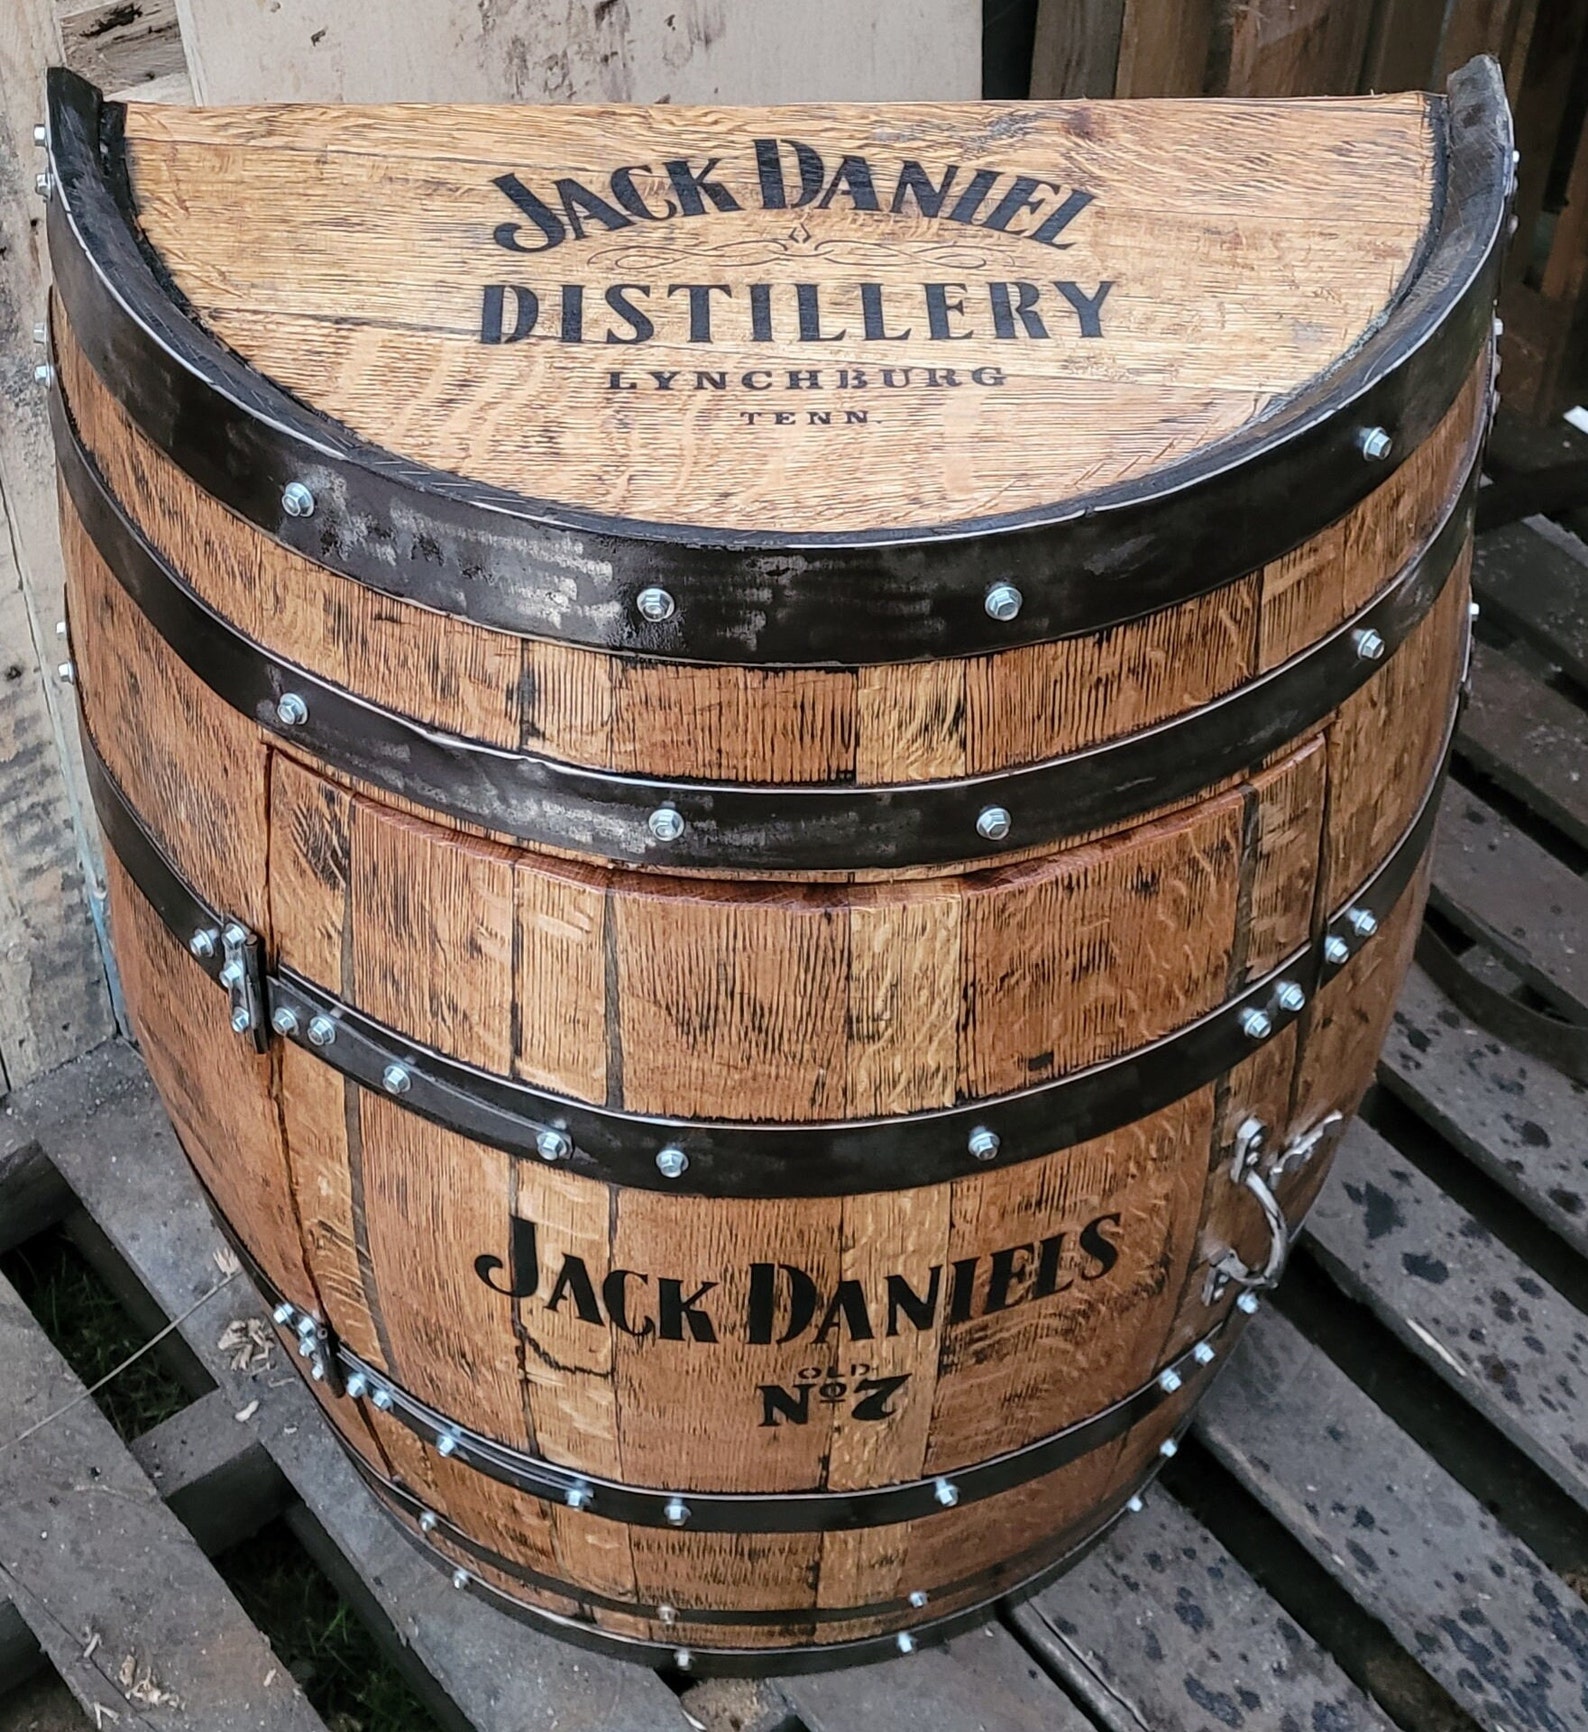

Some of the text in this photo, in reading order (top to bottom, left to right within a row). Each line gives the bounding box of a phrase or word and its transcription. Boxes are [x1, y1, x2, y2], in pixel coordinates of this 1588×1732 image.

[492, 138, 1099, 253] JACK DANIEL
[479, 280, 1119, 345] DISTILLERY
[608, 366, 1007, 391] LYNCHBURG
[473, 1212, 1122, 1345] JACK DANIELS
[797, 1362, 871, 1380] OLD
